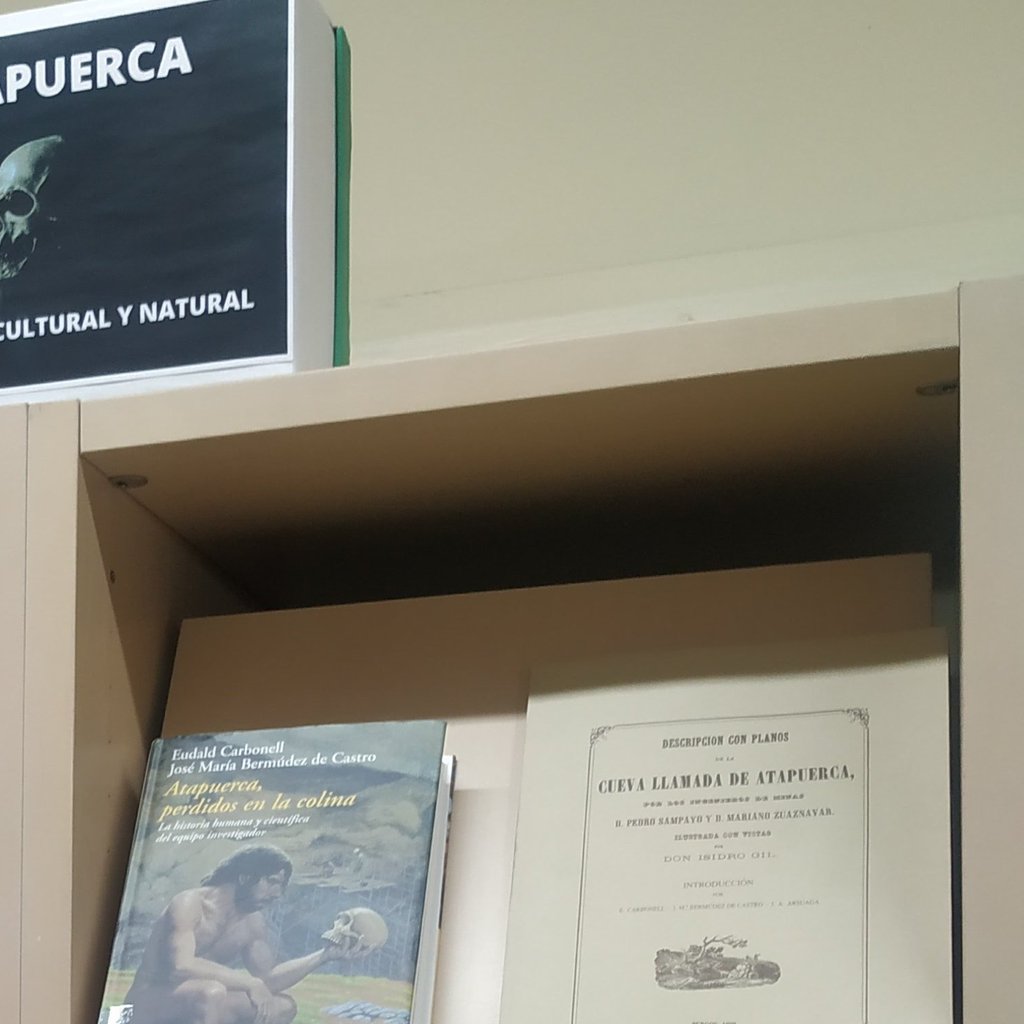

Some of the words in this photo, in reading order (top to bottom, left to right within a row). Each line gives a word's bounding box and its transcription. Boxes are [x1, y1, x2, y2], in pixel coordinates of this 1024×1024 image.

[117, 305, 133, 326] Y
[139, 289, 254, 324] NATURAL
[662, 735, 724, 749] DESCRIPCION
[728, 734, 747, 746] CON
[751, 731, 790, 744] PLANOS
[172, 746, 217, 761] Eudald
[220, 741, 285, 757] Carbonell
[167, 761, 195, 778] José
[198, 757, 237, 773] María
[241, 754, 308, 770] Bermúdez
[311, 752, 327, 766] de
[331, 750, 377, 764] Castro
[598, 777, 645, 793] CUEVA
[651, 773, 723, 791] LLAMADA
[729, 771, 749, 786] DE
[756, 764, 855, 785] ATAPUERCA,
[163, 778, 263, 800] Atapuerca,
[157, 796, 238, 823] perdidos
[243, 799, 265, 812] en
[272, 793, 290, 811] la
[297, 790, 357, 809] colina
[158, 822, 171, 832] La
[173, 820, 209, 831] historia
[212, 818, 253, 829] humana
[254, 820, 261, 828] y
[263, 814, 311, 827] científica
[626, 817, 656, 828] PEDRO
[658, 815, 703, 826] SAMPAYO
[705, 814, 712, 823] Y
[726, 811, 771, 822] MARIANO
[155, 833, 170, 843] del
[172, 832, 204, 845] equipo
[206, 827, 267, 840] investigador
[674, 833, 719, 842] ILUSTRADA
[742, 830, 772, 838] VISTAS
[663, 855, 691, 863] DON
[698, 852, 746, 861] ISIDRO
[683, 878, 754, 889] INTRODUCCIÓN
